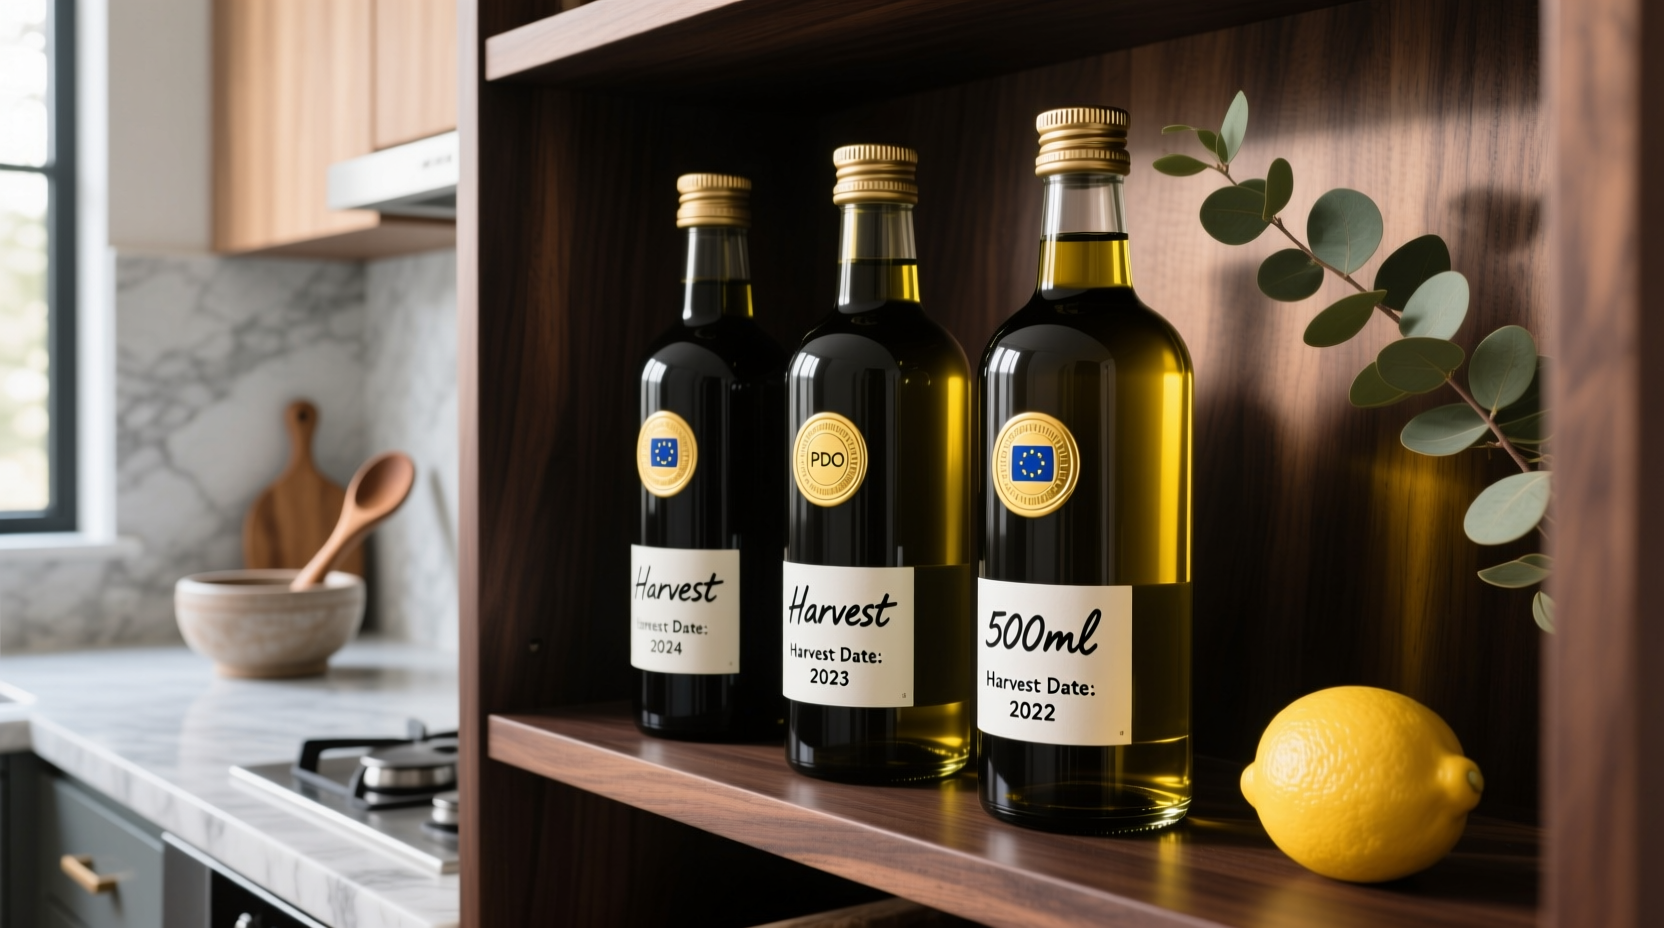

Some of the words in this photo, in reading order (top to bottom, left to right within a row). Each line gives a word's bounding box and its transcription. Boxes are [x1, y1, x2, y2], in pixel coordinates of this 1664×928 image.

[811, 451, 845, 468] PDO
[635, 565, 724, 603] Harvest
[788, 584, 898, 628] Harvest
[672, 619, 708, 636] Date:
[985, 608, 1102, 656] 500ml
[650, 639, 683, 656] 2024
[790, 642, 836, 662] Harvest
[840, 646, 883, 664] Date:
[810, 668, 850, 687] 2023
[986, 669, 1042, 693] Harvest
[1047, 676, 1096, 697] Date:
[1009, 700, 1056, 722] 2022
